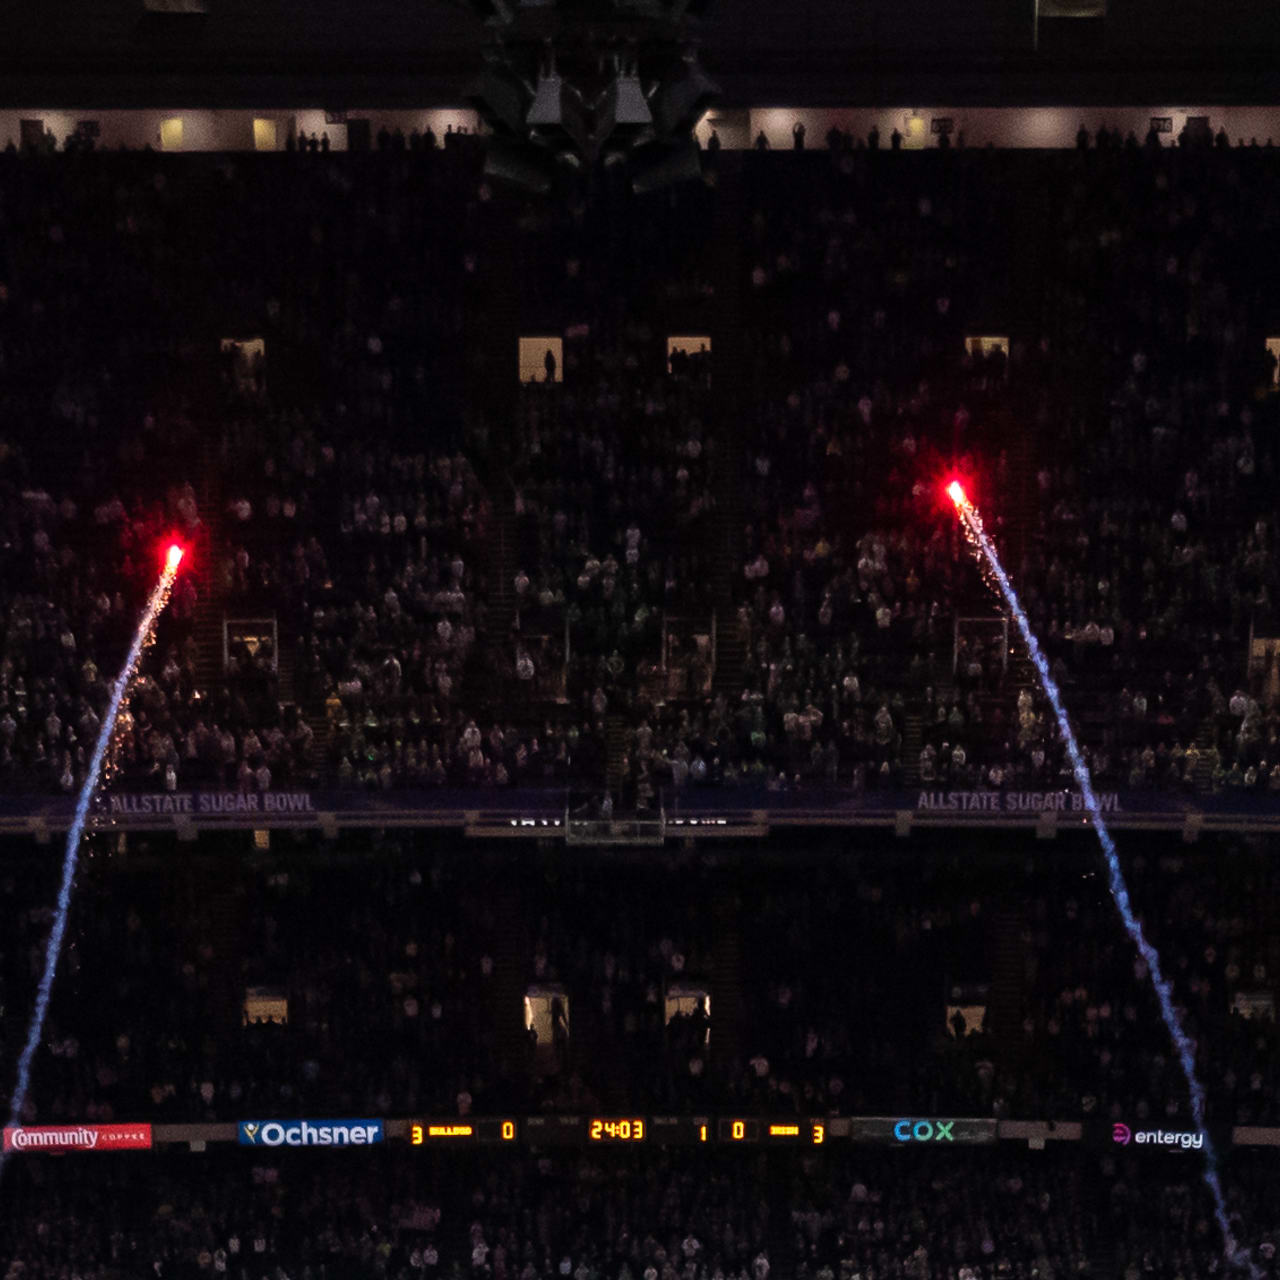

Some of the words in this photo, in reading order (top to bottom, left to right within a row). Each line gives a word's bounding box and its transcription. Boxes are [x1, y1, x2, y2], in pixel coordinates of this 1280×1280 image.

[111, 793, 192, 813] ALLSTATE
[200, 793, 259, 812] SUGAR
[265, 792, 315, 812] BOWL
[918, 791, 999, 811] ALLSTATE
[1006, 791, 1066, 811] SUGAR
[1072, 792, 1122, 812] BWL
[11, 1127, 99, 1149] Community
[261, 1122, 379, 1146] Ochsner
[411, 1126, 423, 1145] 3
[501, 1121, 515, 1140] 0
[591, 1120, 644, 1139] 24:03
[732, 1121, 745, 1139] 0
[813, 1126, 825, 1144] 3
[894, 1120, 954, 1141] COX
[1135, 1130, 1203, 1149] entergy
